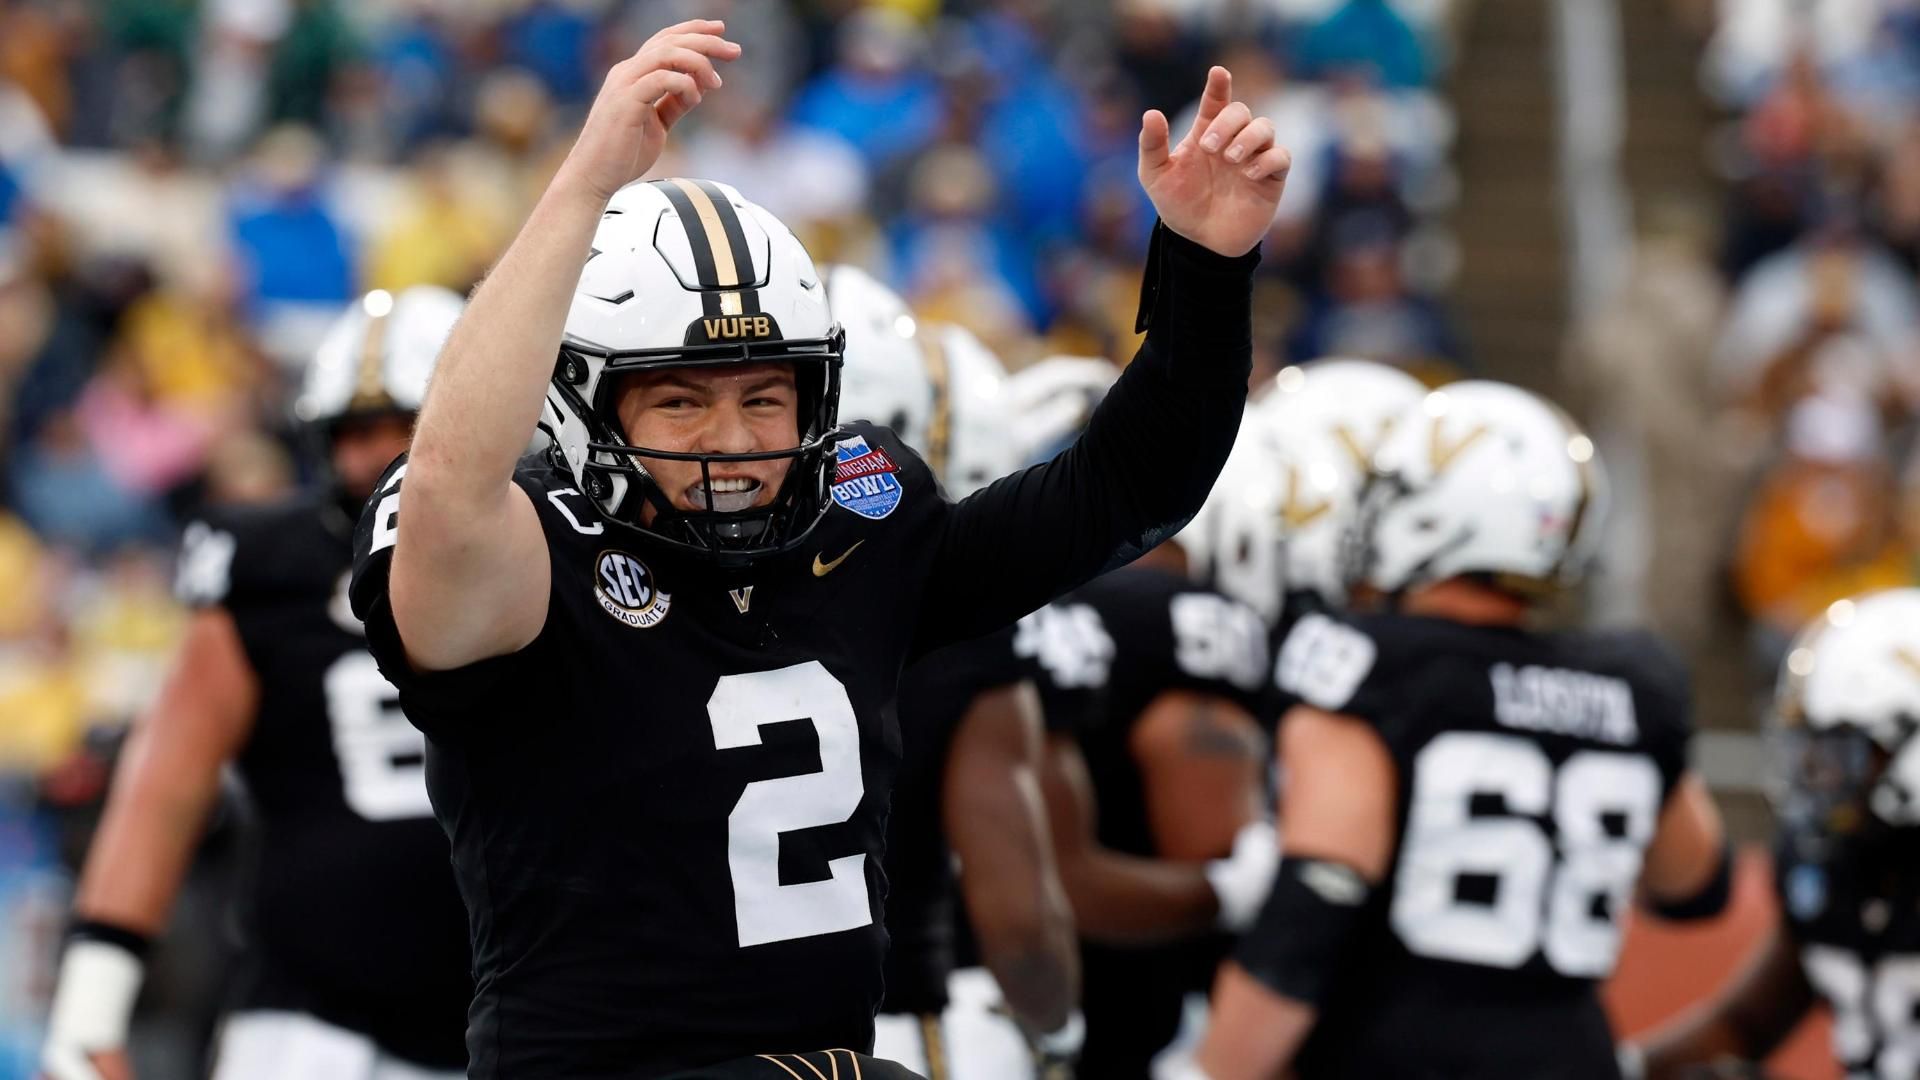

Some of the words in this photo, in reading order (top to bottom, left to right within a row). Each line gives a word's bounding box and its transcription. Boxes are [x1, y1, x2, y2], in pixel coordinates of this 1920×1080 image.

[703, 316, 770, 340] VUFB
[832, 473, 895, 501] BOWL
[600, 553, 650, 607] SEC
[603, 600, 667, 626] GRADUATE
[729, 586, 754, 614] V
[706, 660, 873, 947] 2
[1390, 730, 1663, 980] 68
